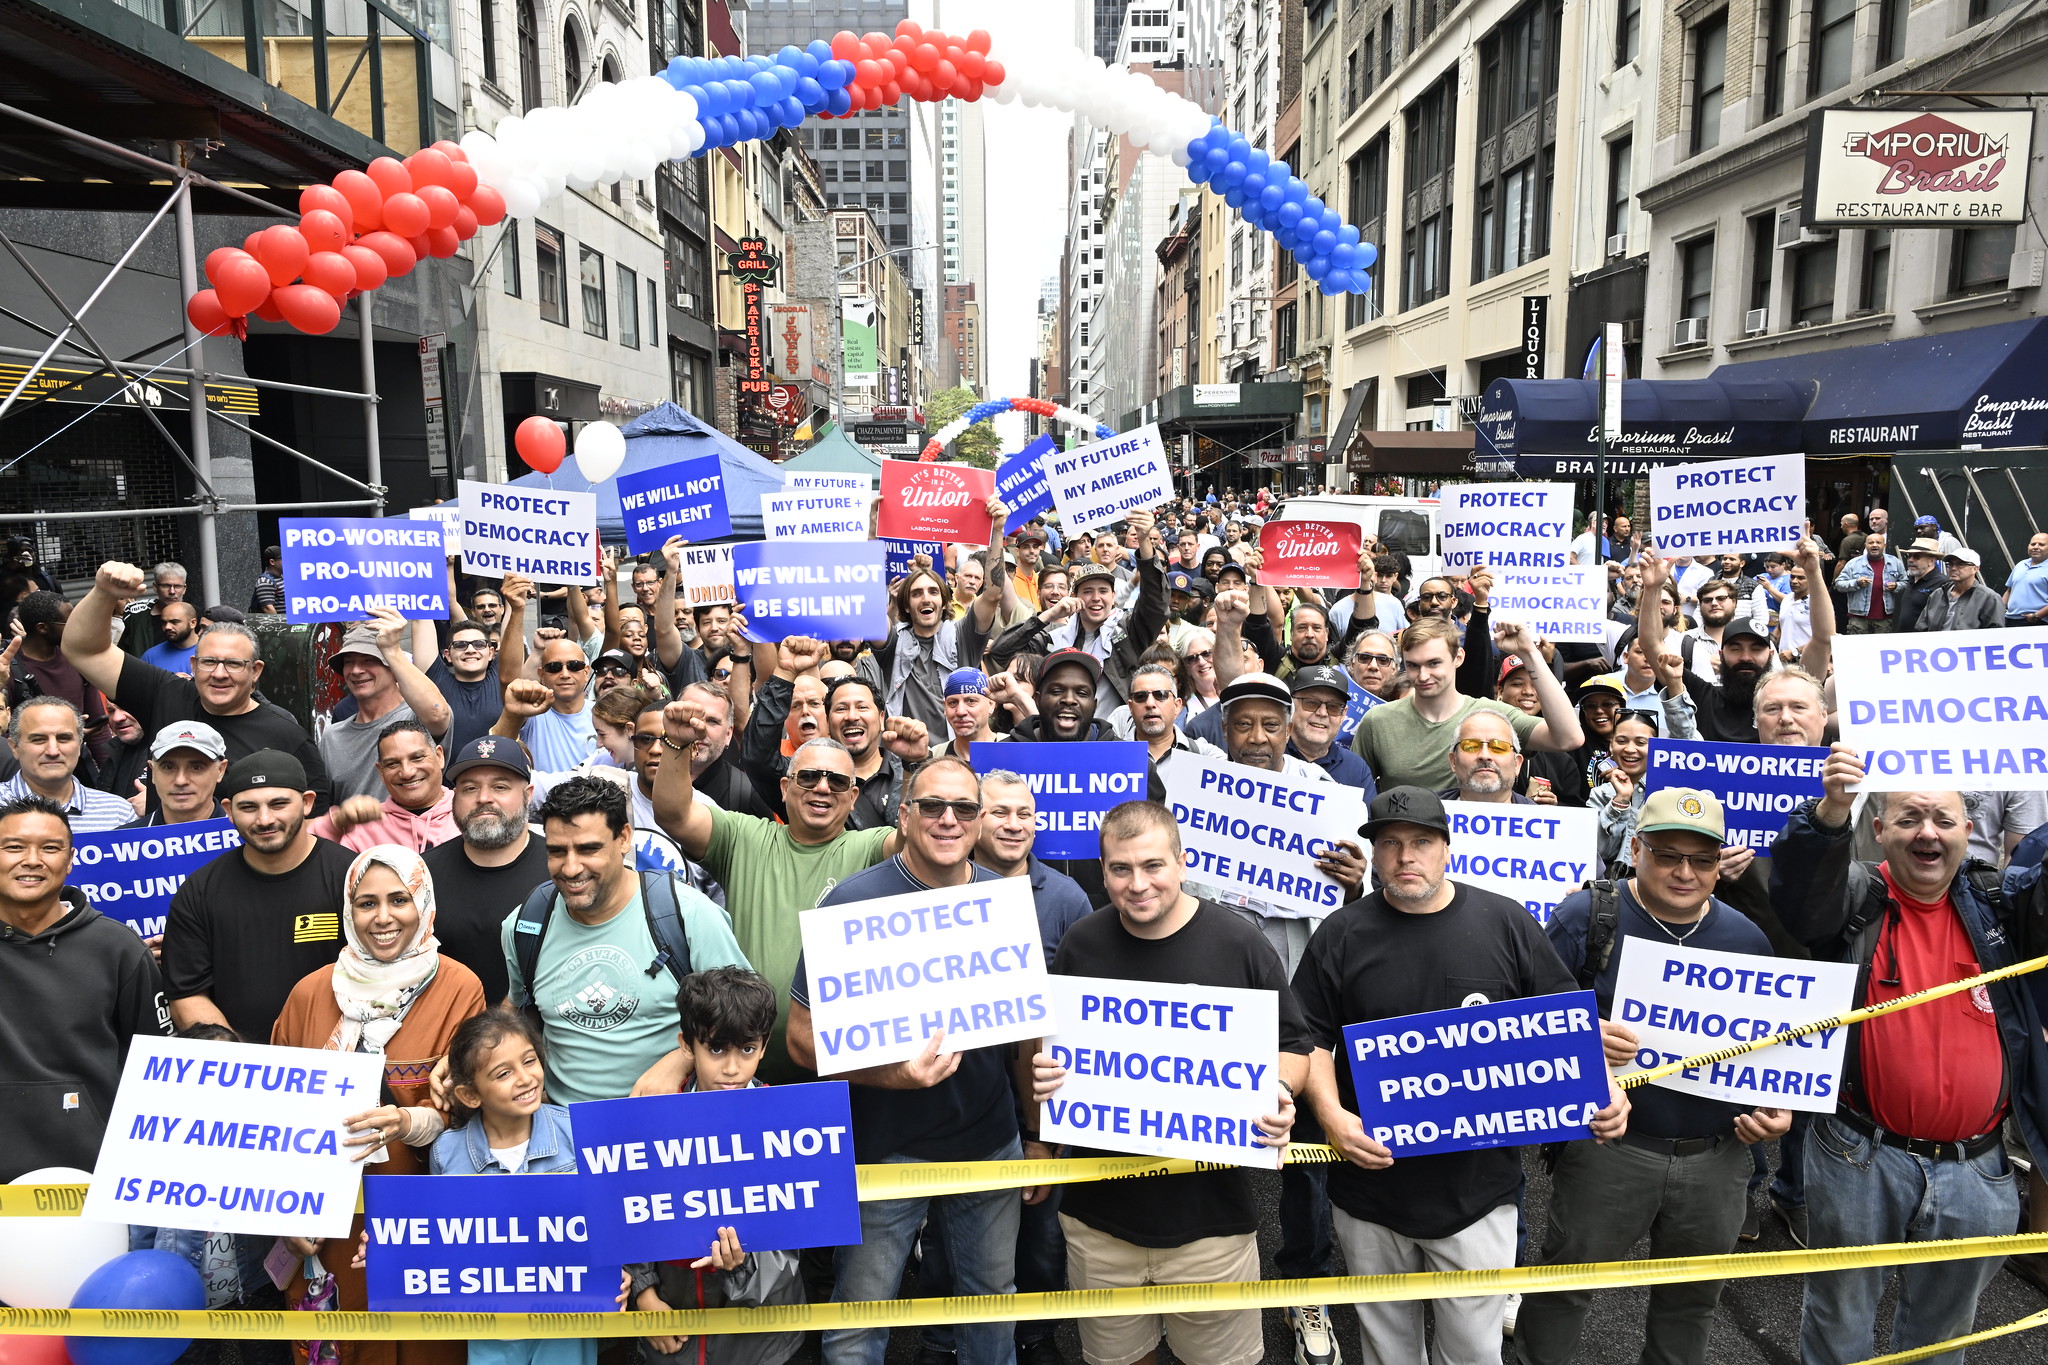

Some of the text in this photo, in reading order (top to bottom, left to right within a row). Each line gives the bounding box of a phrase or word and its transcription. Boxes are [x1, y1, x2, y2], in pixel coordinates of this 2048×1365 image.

[1842, 131, 2010, 158] EMPORIUM
[1876, 158, 2006, 194] Brasil
[1836, 203, 2003, 217] RESTAURANT & BAR
[742, 241, 763, 251] BAR
[738, 260, 769, 270] GRILL
[744, 283, 760, 293] St.
[914, 299, 922, 333] PARK
[782, 316, 802, 375] JEWELRY
[1526, 298, 1540, 379] LIQUOR
[741, 381, 770, 393] PUB
[1964, 411, 2015, 431] Brasil
[1829, 425, 1919, 444] RESTAURANT
[1963, 430, 2013, 438] RESTAURANT
[747, 444, 770, 452] PUB
[1055, 458, 1079, 476] MY
[1081, 442, 1138, 468] FUTURE
[1622, 446, 1691, 454] RESTAURANT
[794, 478, 811, 488] MY
[814, 479, 857, 489] FUTURE
[910, 468, 965, 489] IT'S BETTER
[1000, 467, 1033, 492] WILL
[1063, 460, 1157, 500] MY AMERICA
[1676, 466, 1776, 490] PROTECT
[480, 492, 570, 516] PROTECT
[622, 475, 721, 511] WE WILL NOT
[772, 500, 794, 513] MY
[797, 498, 852, 511] FUTURE
[901, 485, 972, 508] Union
[1073, 486, 1162, 525] IS PRO-UNION
[1459, 492, 1548, 508] PROTECT
[637, 504, 713, 534] BE SILENT
[1656, 494, 1798, 521] DEMOCRACY
[286, 528, 441, 548] PRO-WORKER
[464, 520, 590, 547] DEMOCRACY
[776, 521, 864, 537] MY AMERICA
[1284, 523, 1334, 540] IT'S BETTER
[1444, 522, 1565, 538] DEMOCRACY
[1655, 525, 1801, 550] VOTE HARRIS
[687, 550, 716, 565] NEW
[886, 542, 941, 554] WILL NOT
[1276, 539, 1340, 560] Union
[1443, 551, 1566, 568] VOTE HARRIS
[301, 561, 433, 580] PRO-UNION
[464, 550, 592, 577] VOTE HARRIS
[736, 564, 882, 586] WE WILL NOT
[292, 594, 445, 614] PRO-AMERICA
[753, 595, 865, 617] BE SILENT
[1488, 596, 1601, 610] DEMOCRACY
[1535, 621, 1603, 635] HARRIS
[1021, 772, 1144, 793] WILL NOT
[1200, 769, 1325, 815] PROTECT
[1172, 803, 1343, 863] DEMOCRACY
[1237, 861, 1339, 906] HARRIS
[842, 897, 993, 945] PROTECT
[818, 943, 1031, 1003] DEMOCRACY
[1661, 959, 1816, 999] PROTECT
[563, 1008, 627, 1028] COLUMBIA
[820, 993, 1047, 1056] VOTE HARRIS
[1080, 994, 1234, 1032] PROTECT
[1355, 1007, 1592, 1061] PRO-WORKER
[143, 1055, 355, 1097] MY FUTURE +
[1050, 1044, 1267, 1091] DEMOCRACY
[1379, 1056, 1581, 1102] PRO-UNION
[1709, 1061, 1832, 1098] HARRIS
[128, 1114, 338, 1156] MY AMERICA
[1047, 1099, 1268, 1149] VOTE HARRIS
[1372, 1102, 1599, 1147] PRO-AMERICA
[582, 1125, 846, 1175] WE WILL NOT
[114, 1177, 325, 1215] IS PRO-UNION
[623, 1180, 820, 1225] BE SILENT
[371, 1215, 588, 1245] WE WILL NO
[403, 1265, 587, 1295] BE SILENT
